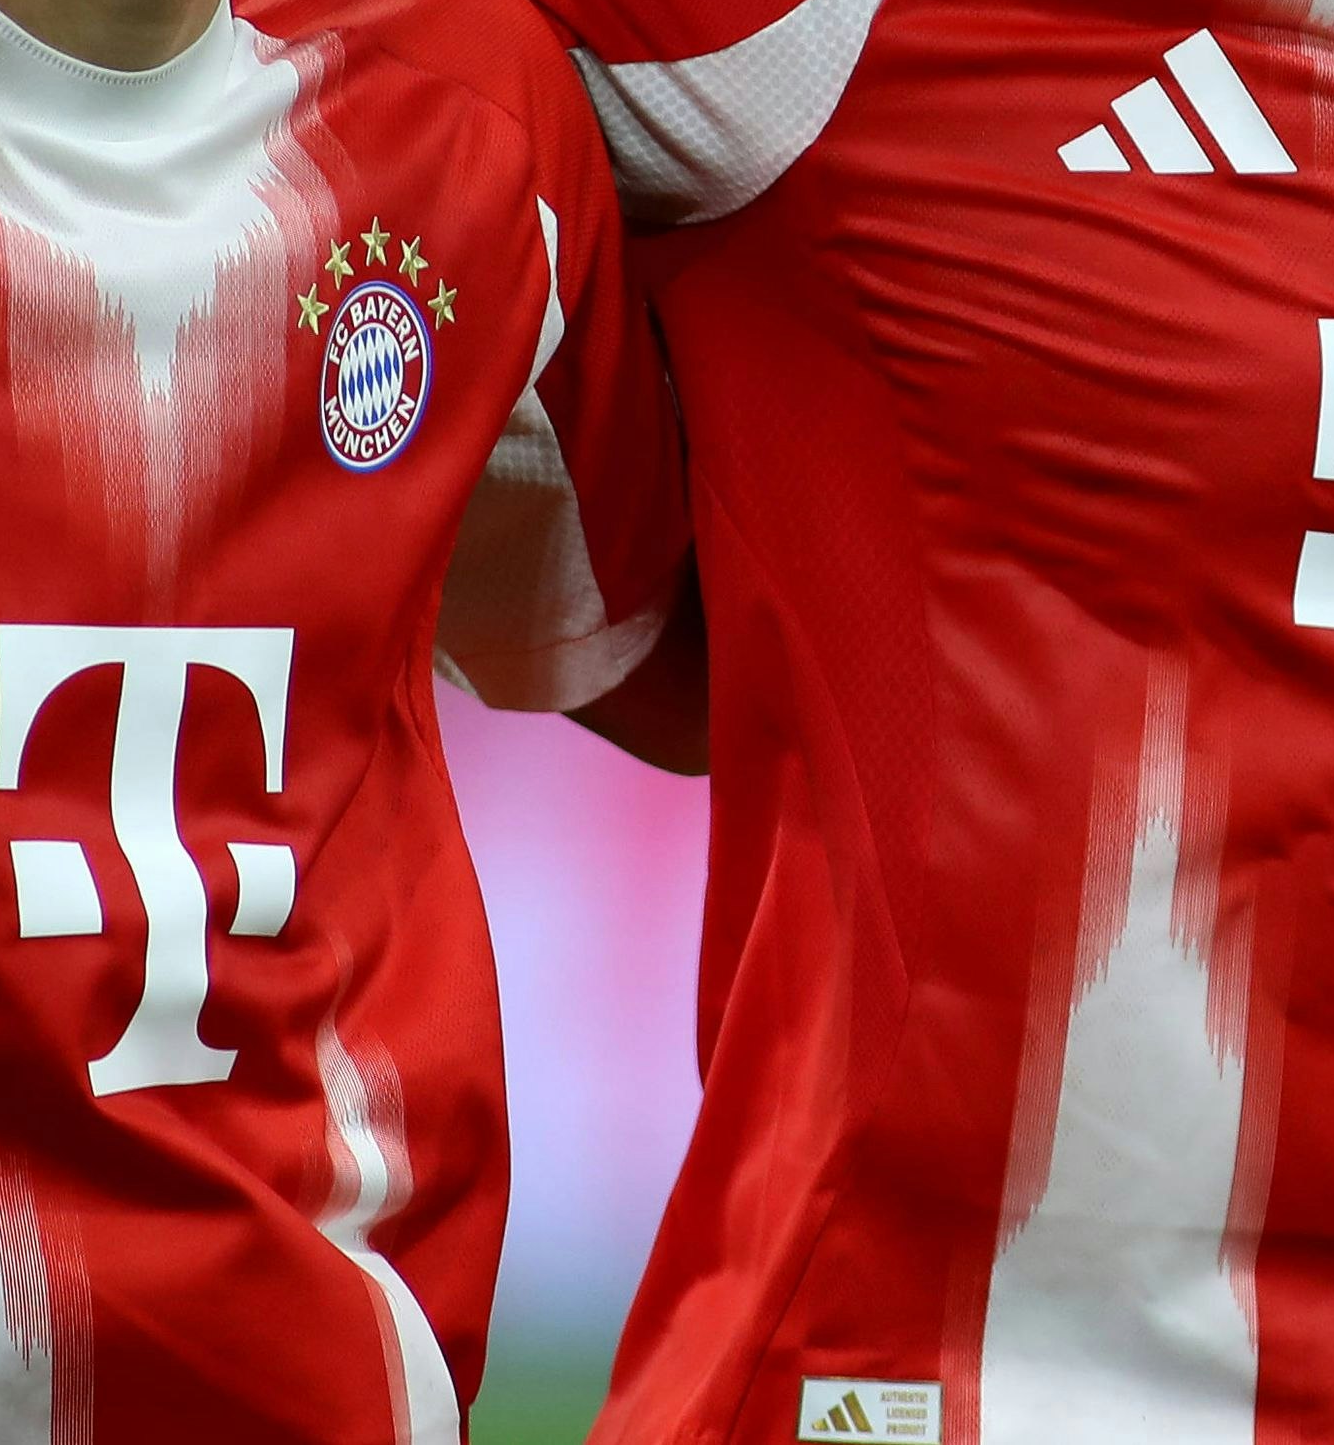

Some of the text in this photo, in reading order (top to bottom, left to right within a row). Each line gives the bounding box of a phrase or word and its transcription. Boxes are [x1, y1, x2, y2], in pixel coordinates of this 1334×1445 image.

[328, 295, 421, 365] FC BAYERN
[324, 392, 417, 459] MÜNCHEN
